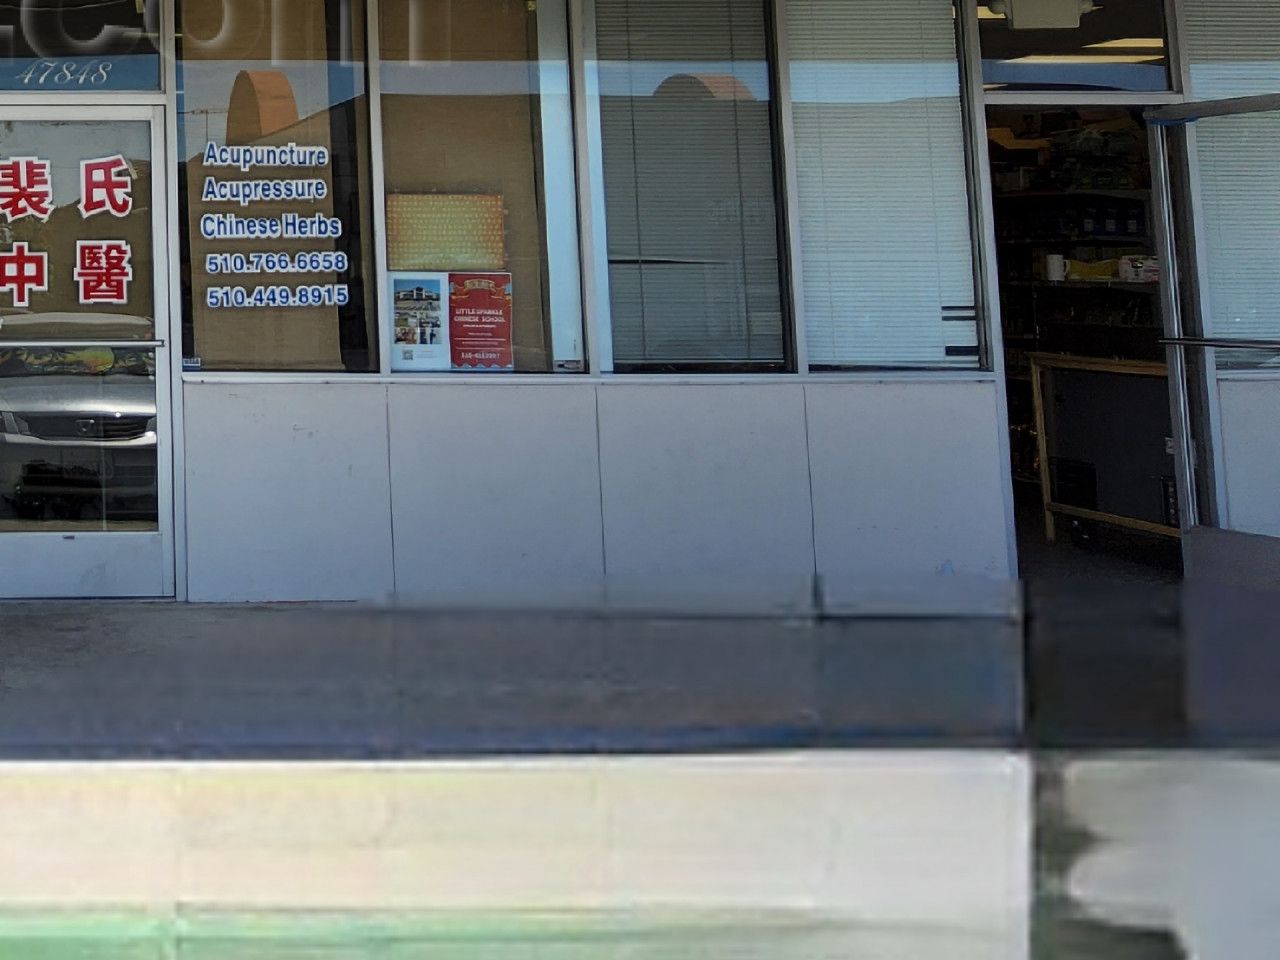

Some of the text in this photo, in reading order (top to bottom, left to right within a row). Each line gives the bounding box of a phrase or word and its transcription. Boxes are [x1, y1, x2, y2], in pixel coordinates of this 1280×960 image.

[17, 61, 112, 85] 47848
[203, 142, 328, 171] Acupuncture
[202, 177, 327, 206] Acupressure
[201, 212, 342, 237] Chinese Herbs
[206, 252, 348, 273] 510.766.6658
[207, 285, 349, 307] 510.449.8915
